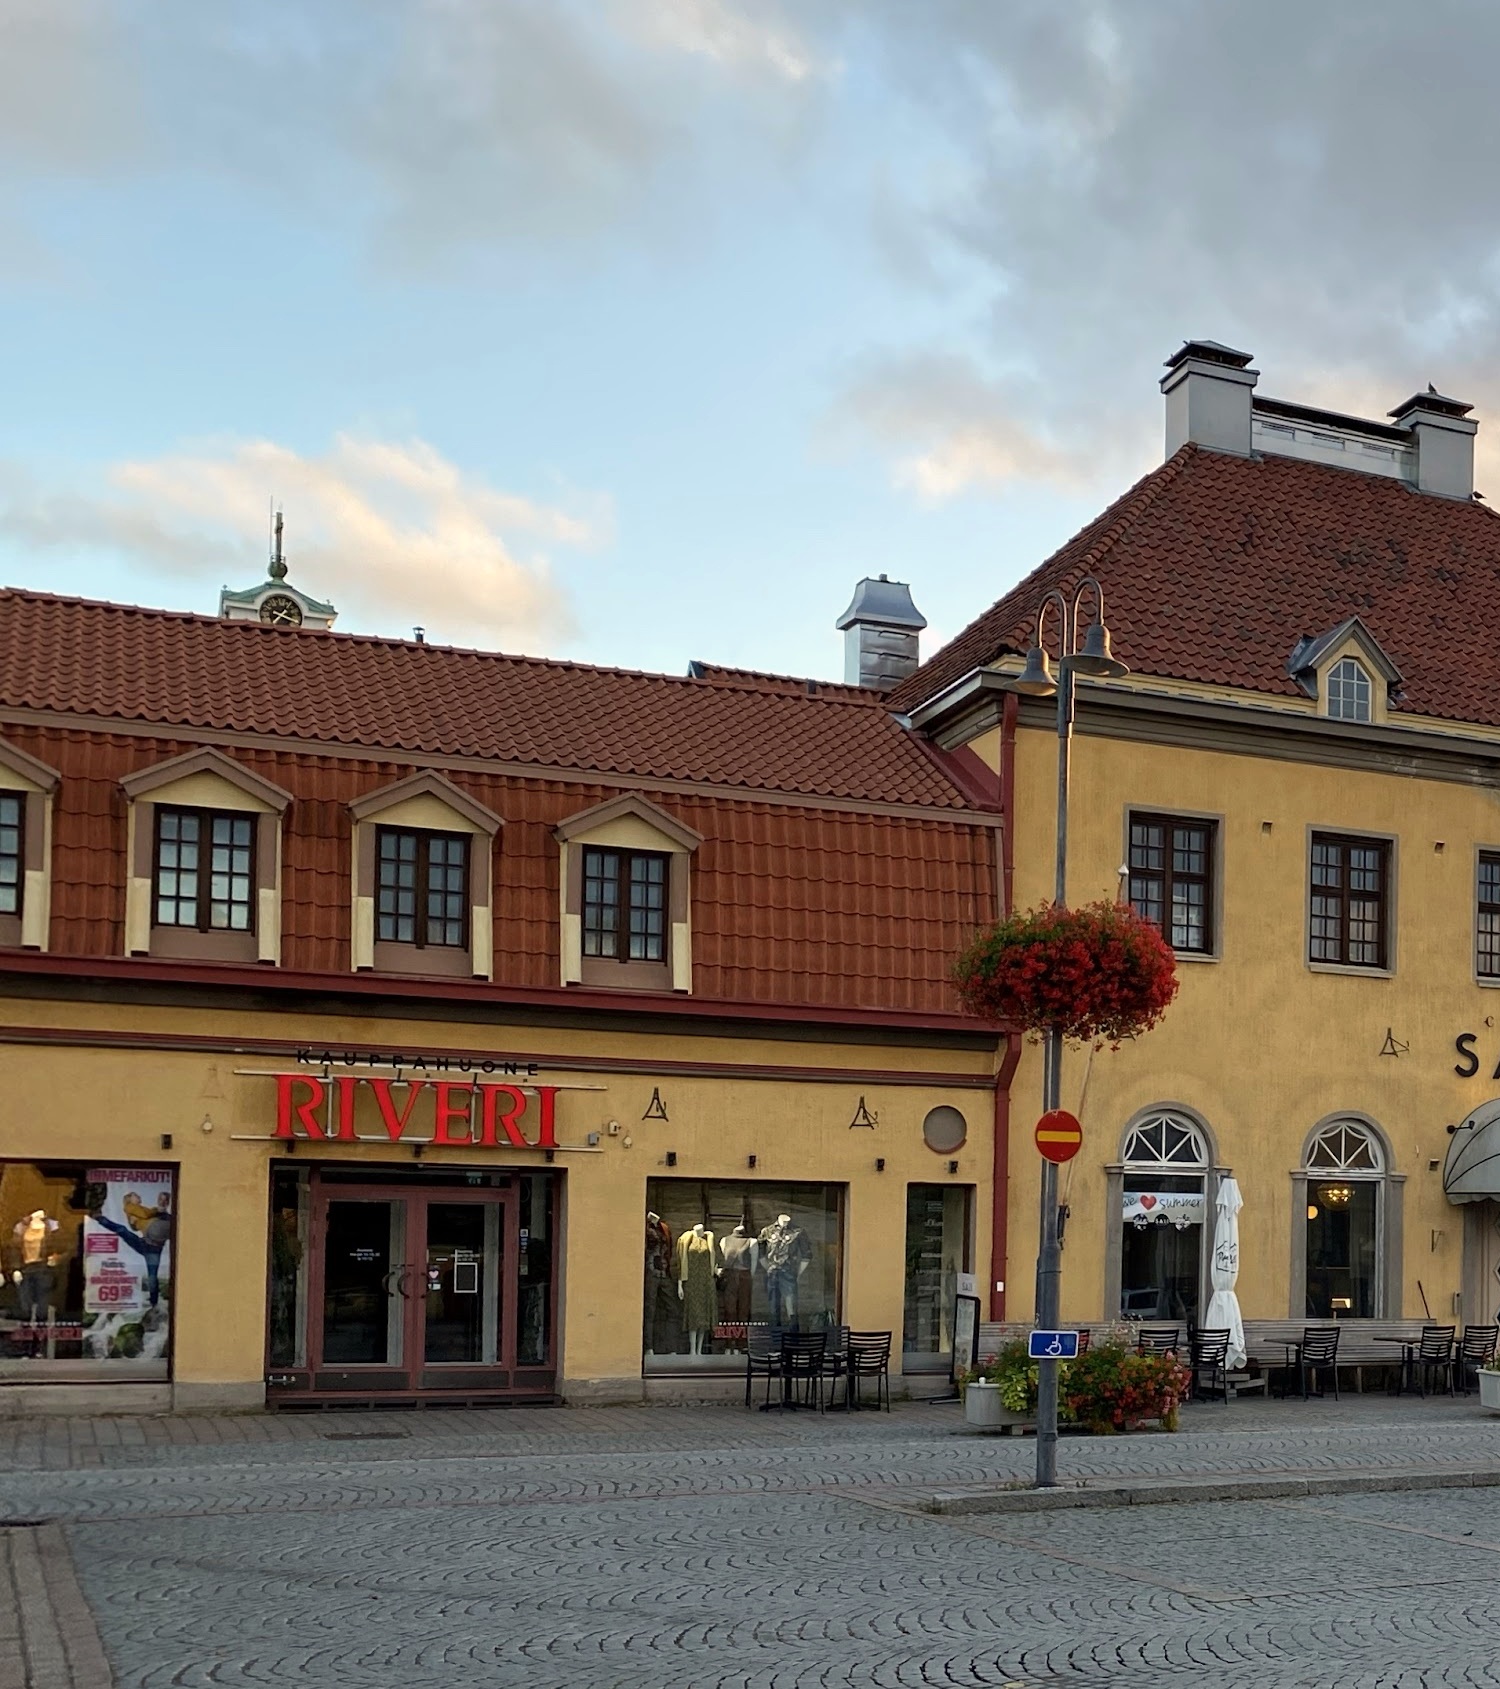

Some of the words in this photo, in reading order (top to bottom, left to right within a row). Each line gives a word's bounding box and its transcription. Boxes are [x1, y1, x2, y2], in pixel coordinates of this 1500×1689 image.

[297, 1049, 539, 1077] KAUPPAHUONE
[271, 1074, 560, 1149] RIVERI
[1159, 1199, 1202, 1210] summer
[99, 1286, 120, 1302] 69
